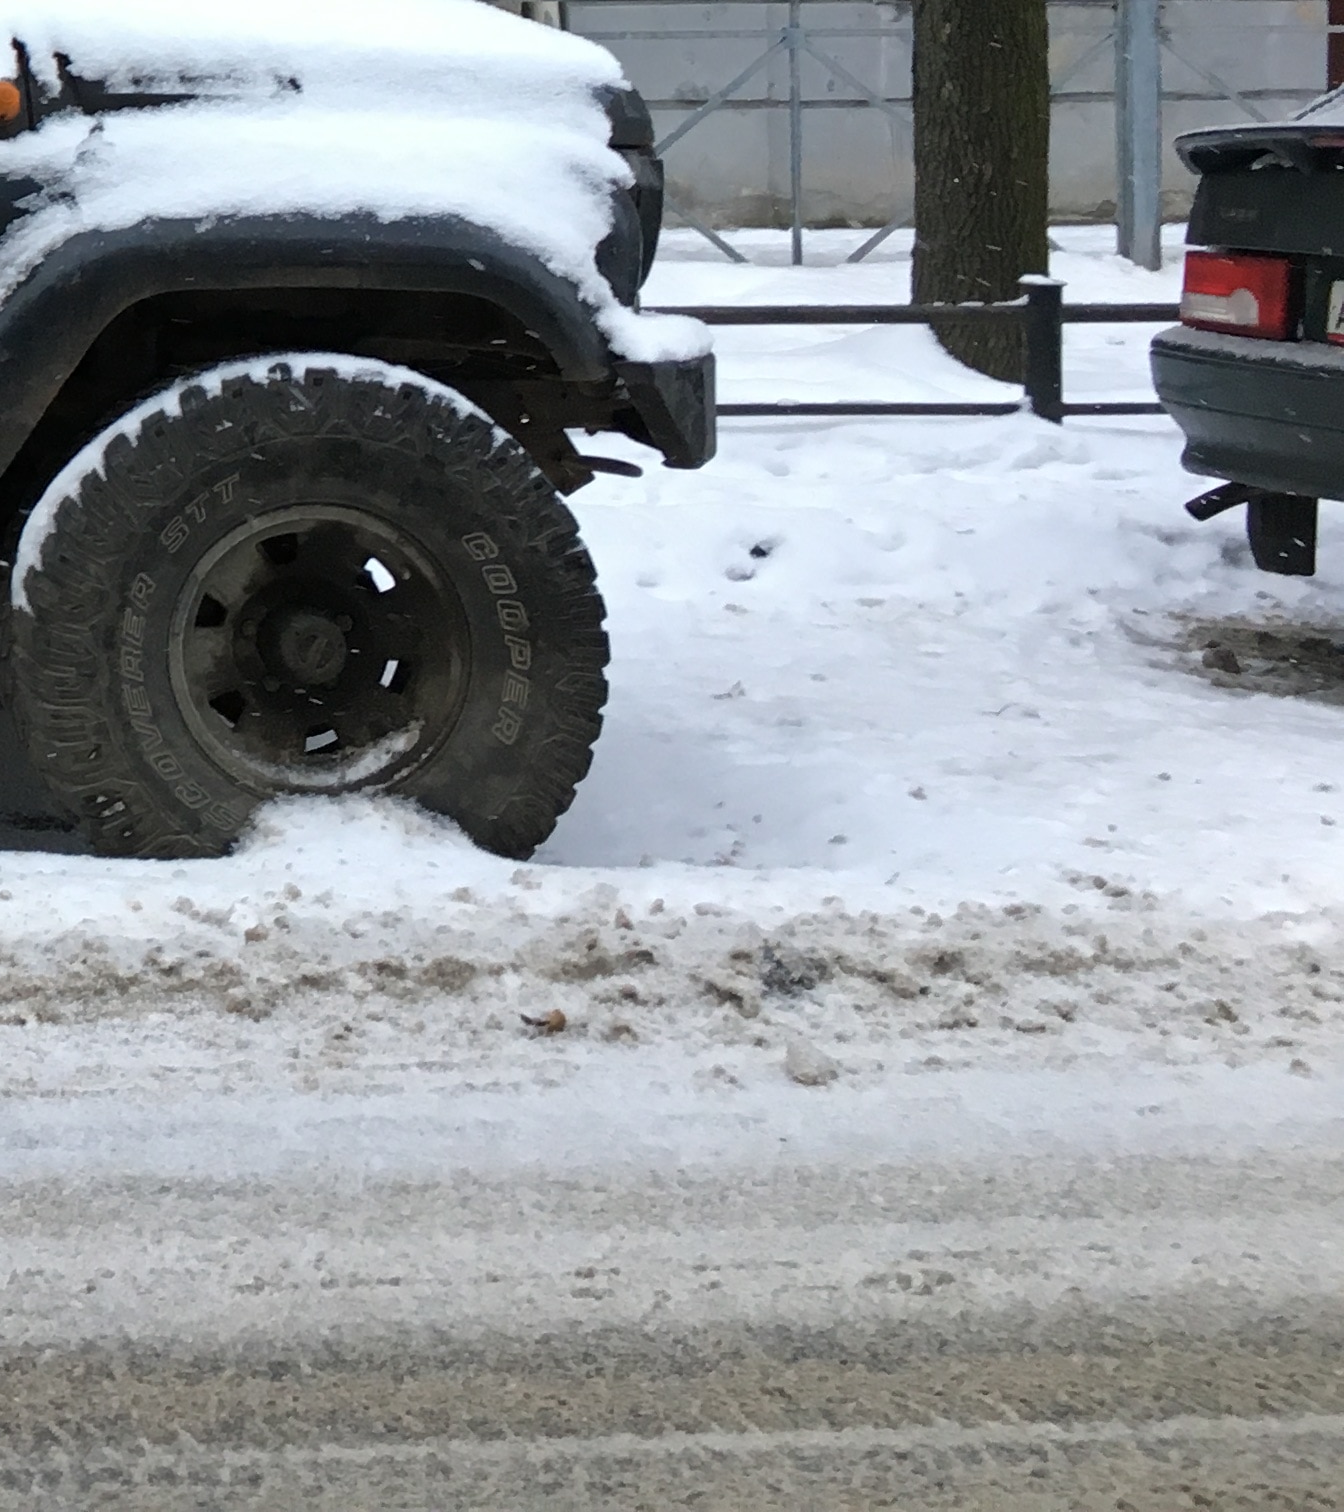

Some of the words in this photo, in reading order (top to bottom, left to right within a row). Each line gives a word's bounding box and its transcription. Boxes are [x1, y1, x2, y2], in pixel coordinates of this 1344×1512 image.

[161, 472, 241, 554] STT
[118, 572, 244, 832] SCOVERER
[461, 532, 532, 745] COOPER
